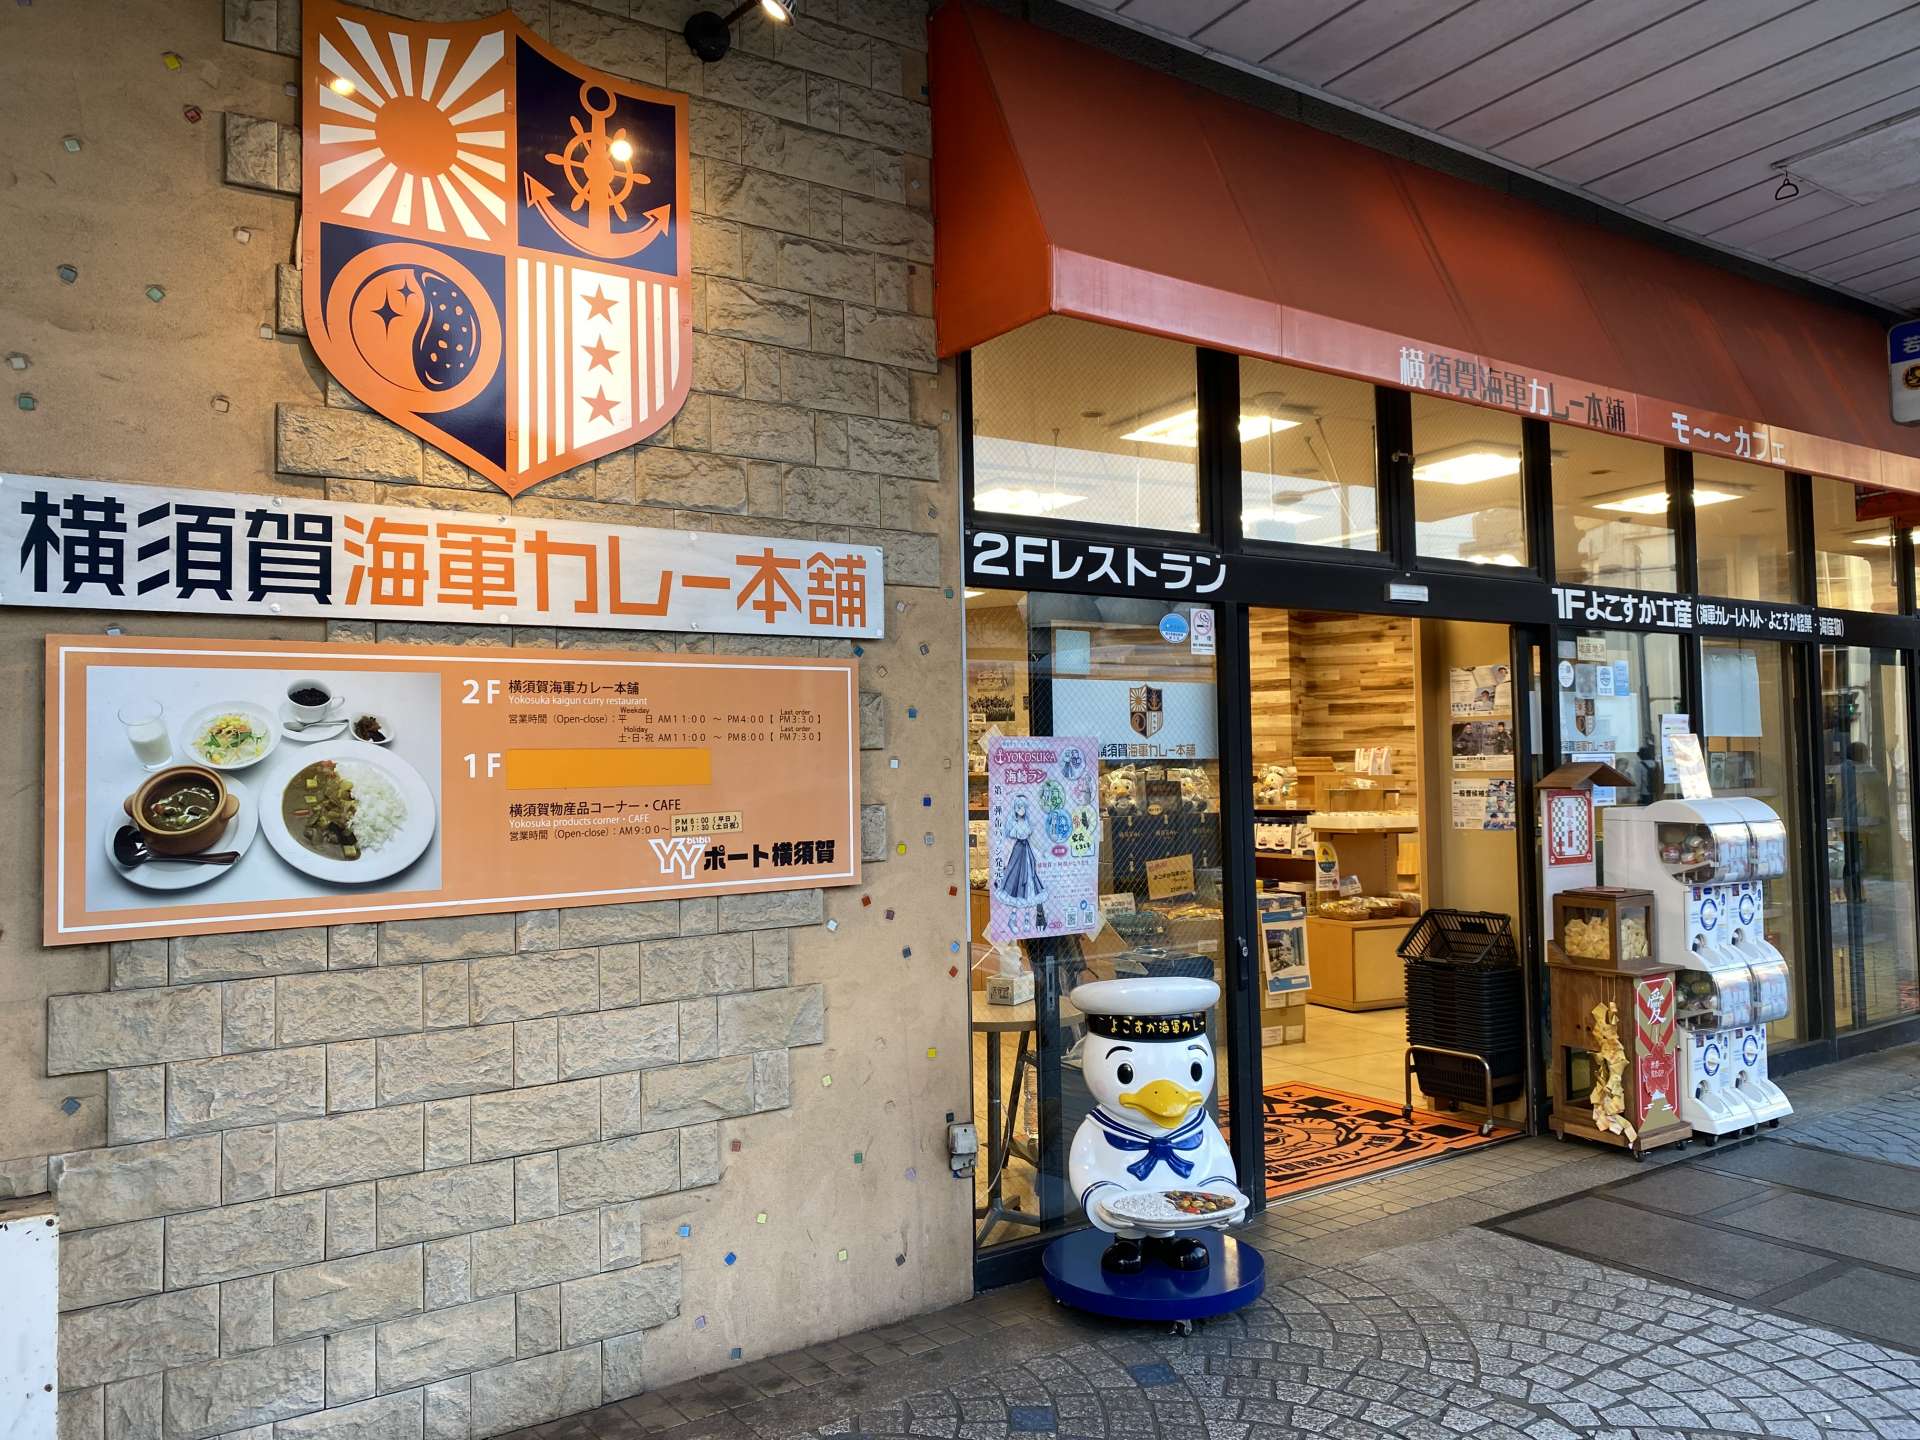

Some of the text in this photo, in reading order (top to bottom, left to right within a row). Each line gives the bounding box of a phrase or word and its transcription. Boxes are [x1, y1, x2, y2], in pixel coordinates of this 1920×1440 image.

[1400, 346, 1627, 433] 横須賀海軍カレー本舗
[20, 490, 867, 628] 横須賀海軍カレー本舗
[973, 532, 1227, 594] 2Fレストラン
[508, 679, 640, 695] 横須賀海軍カレー本舗
[508, 695, 648, 707] Yokosuka kaigun curry restaurant
[619, 706, 650, 715] Weekday
[623, 726, 649, 734] Holiday
[1005, 751, 1058, 763] YOKOSUKA
[508, 818, 551, 829] Yokosuka
[553, 817, 593, 829] products
[703, 839, 836, 871] ポート横須賀
[1647, 987, 1667, 1024] 愛
